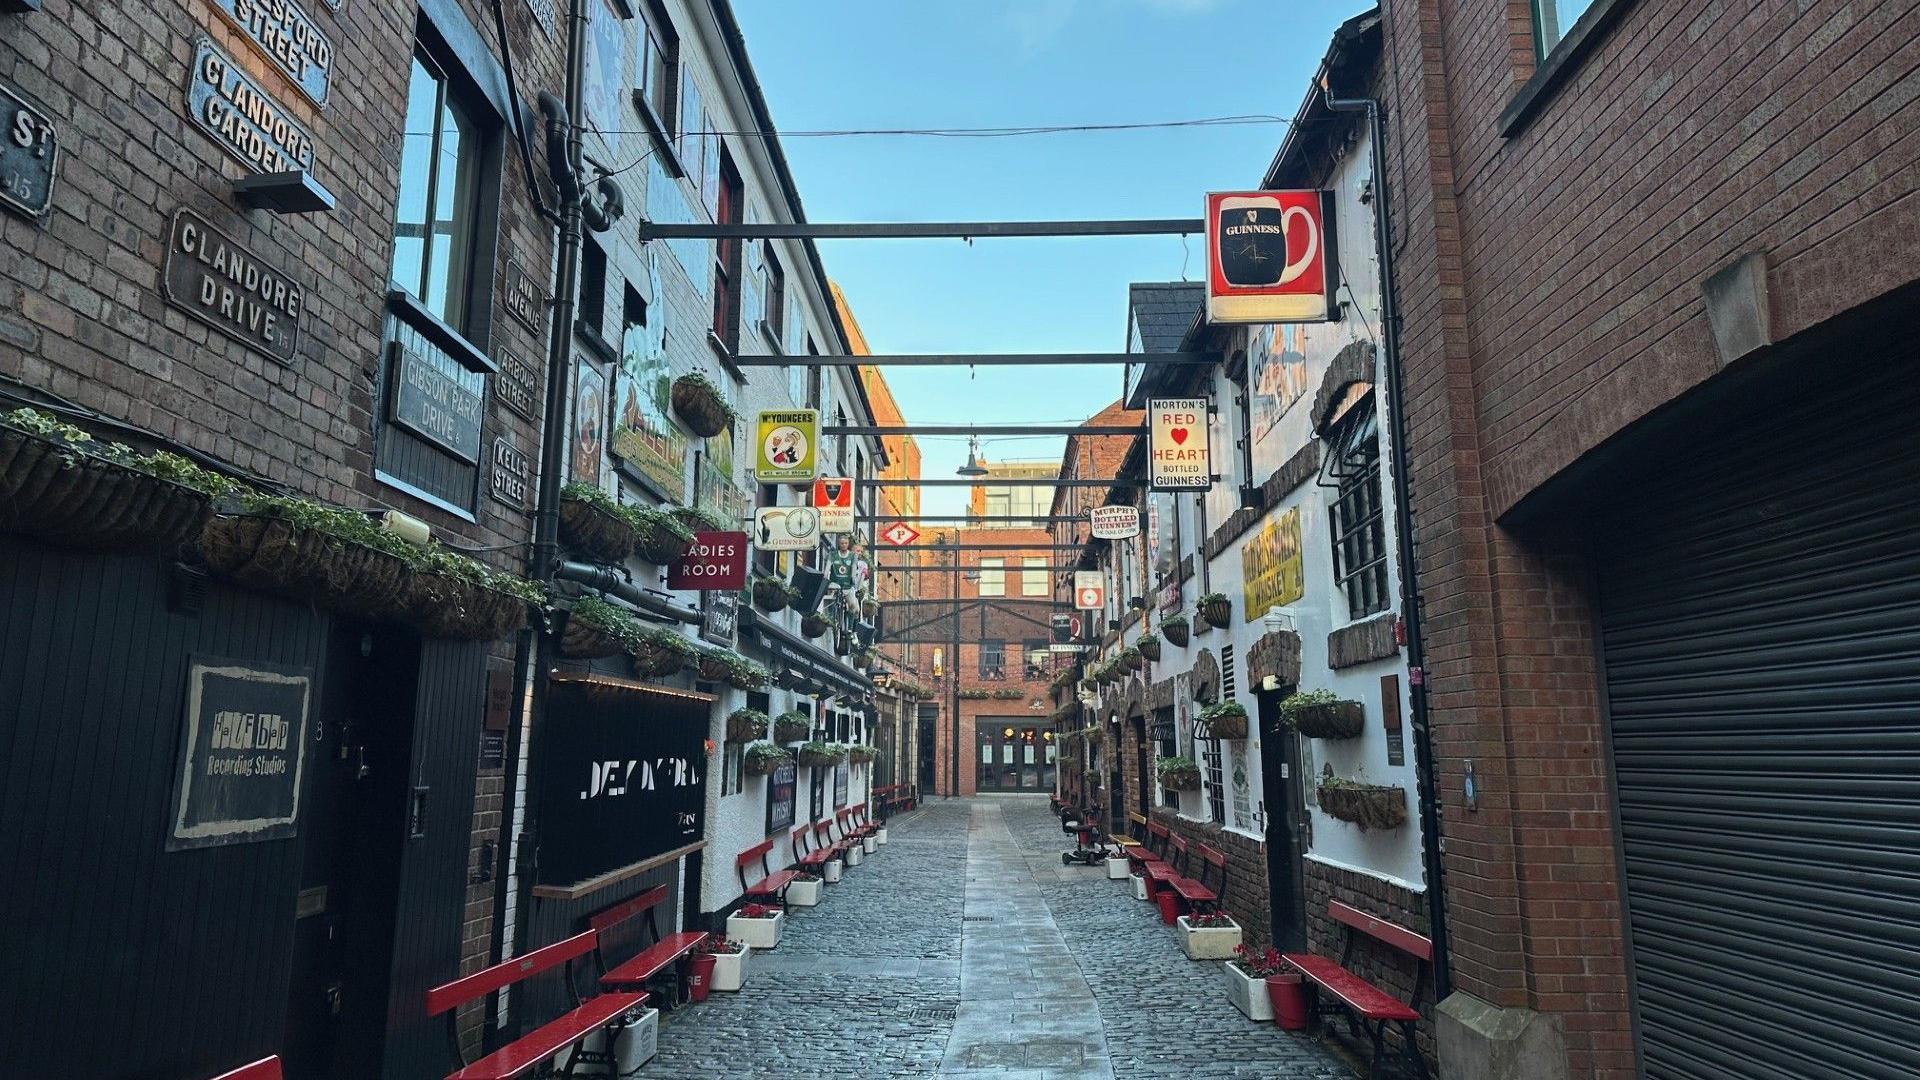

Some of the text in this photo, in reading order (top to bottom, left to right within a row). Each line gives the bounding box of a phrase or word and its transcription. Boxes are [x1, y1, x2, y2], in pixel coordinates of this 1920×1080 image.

[236, 0, 308, 81] STREET
[1226, 225, 1280, 235] GUINNESS
[519, 273, 533, 302] AVA
[202, 274, 276, 341] DRIVE
[509, 289, 540, 330] AVENUE
[501, 353, 535, 392] ARBOUR
[407, 360, 479, 424] GIBSON PARK
[500, 377, 533, 417] STREET
[1153, 401, 1205, 409] MORTON'S
[422, 402, 455, 441] DRIVE
[1162, 414, 1195, 424] RED
[497, 444, 529, 479] KELLS
[1153, 449, 1208, 460] HEART
[1163, 465, 1199, 473] BOTTLED
[495, 470, 527, 501] STREET
[1156, 476, 1208, 485] GUINNESS
[1094, 507, 1136, 517] MURPHY
[1094, 515, 1137, 523] BOTTLED
[681, 544, 735, 557] ADIES
[682, 564, 730, 576] ROOM
[208, 756, 286, 777] Recording Studios
